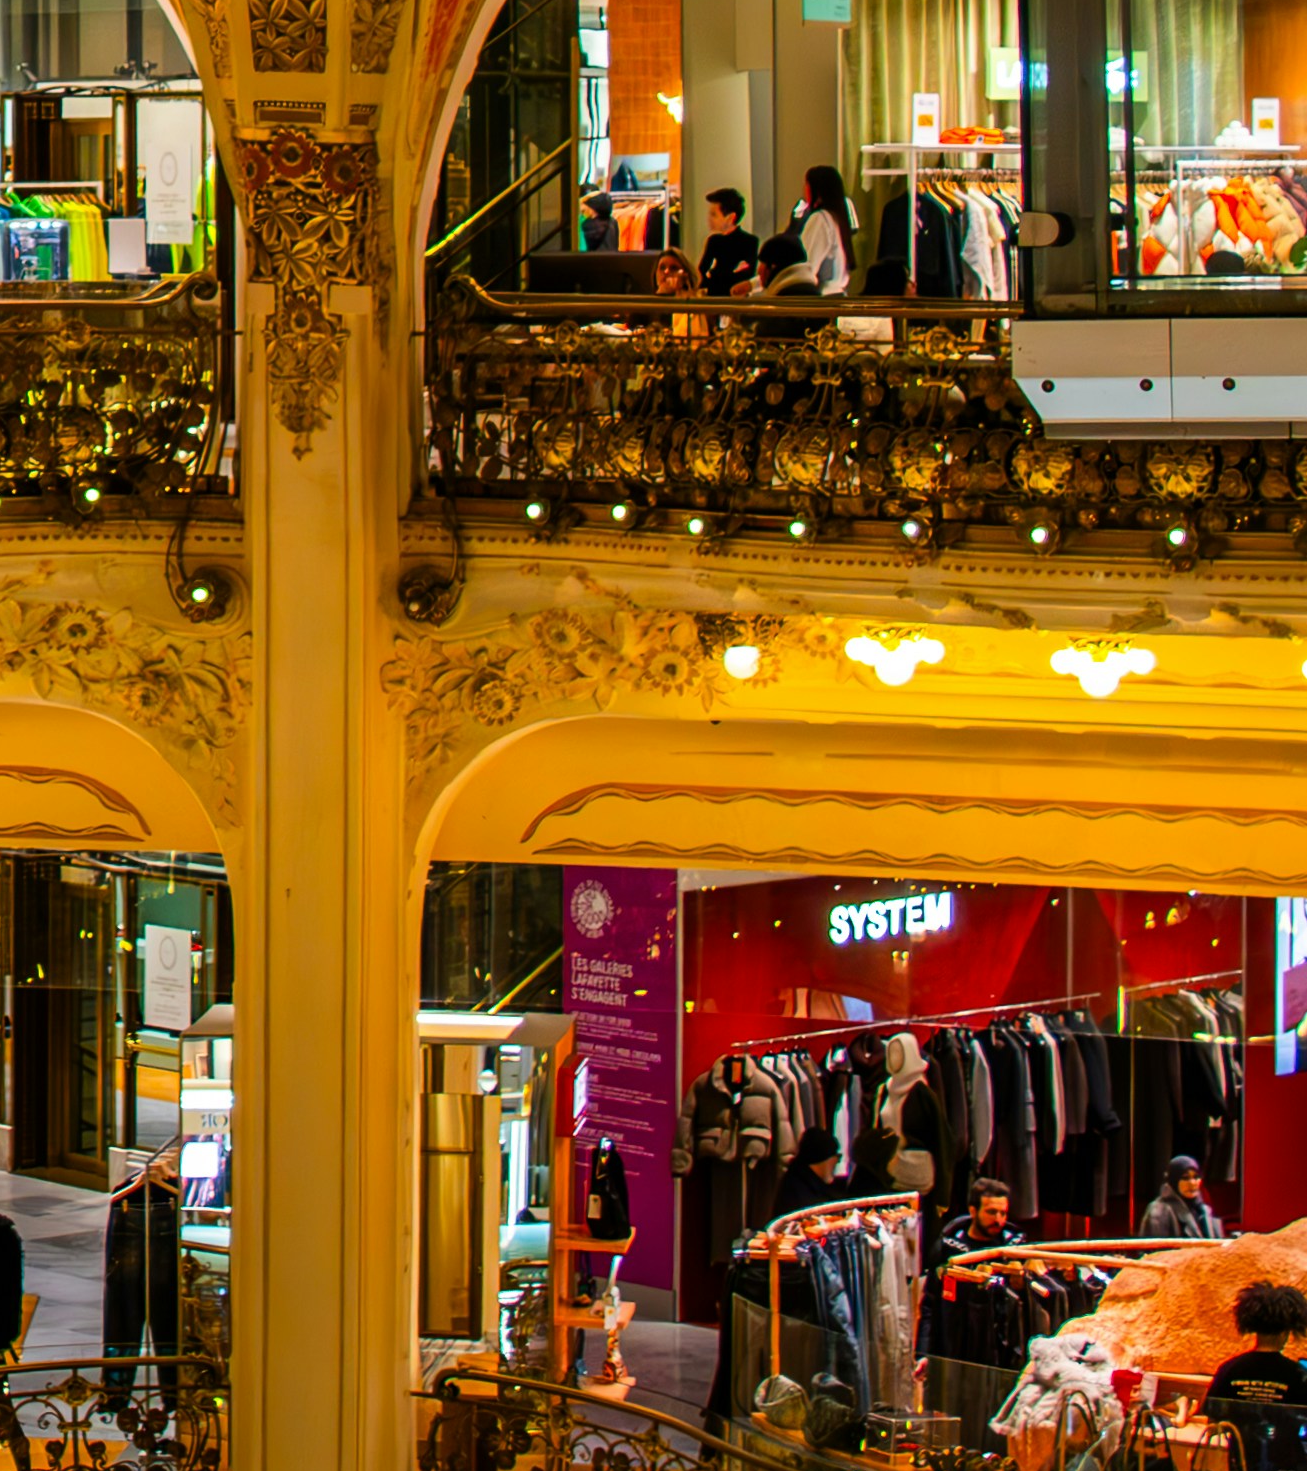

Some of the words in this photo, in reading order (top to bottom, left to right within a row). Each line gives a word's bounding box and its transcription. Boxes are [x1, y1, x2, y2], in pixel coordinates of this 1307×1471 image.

[828, 891, 954, 945] SYSTEM
[589, 958, 634, 978] GALERIES
[571, 969, 622, 992] LAFAYETTE
